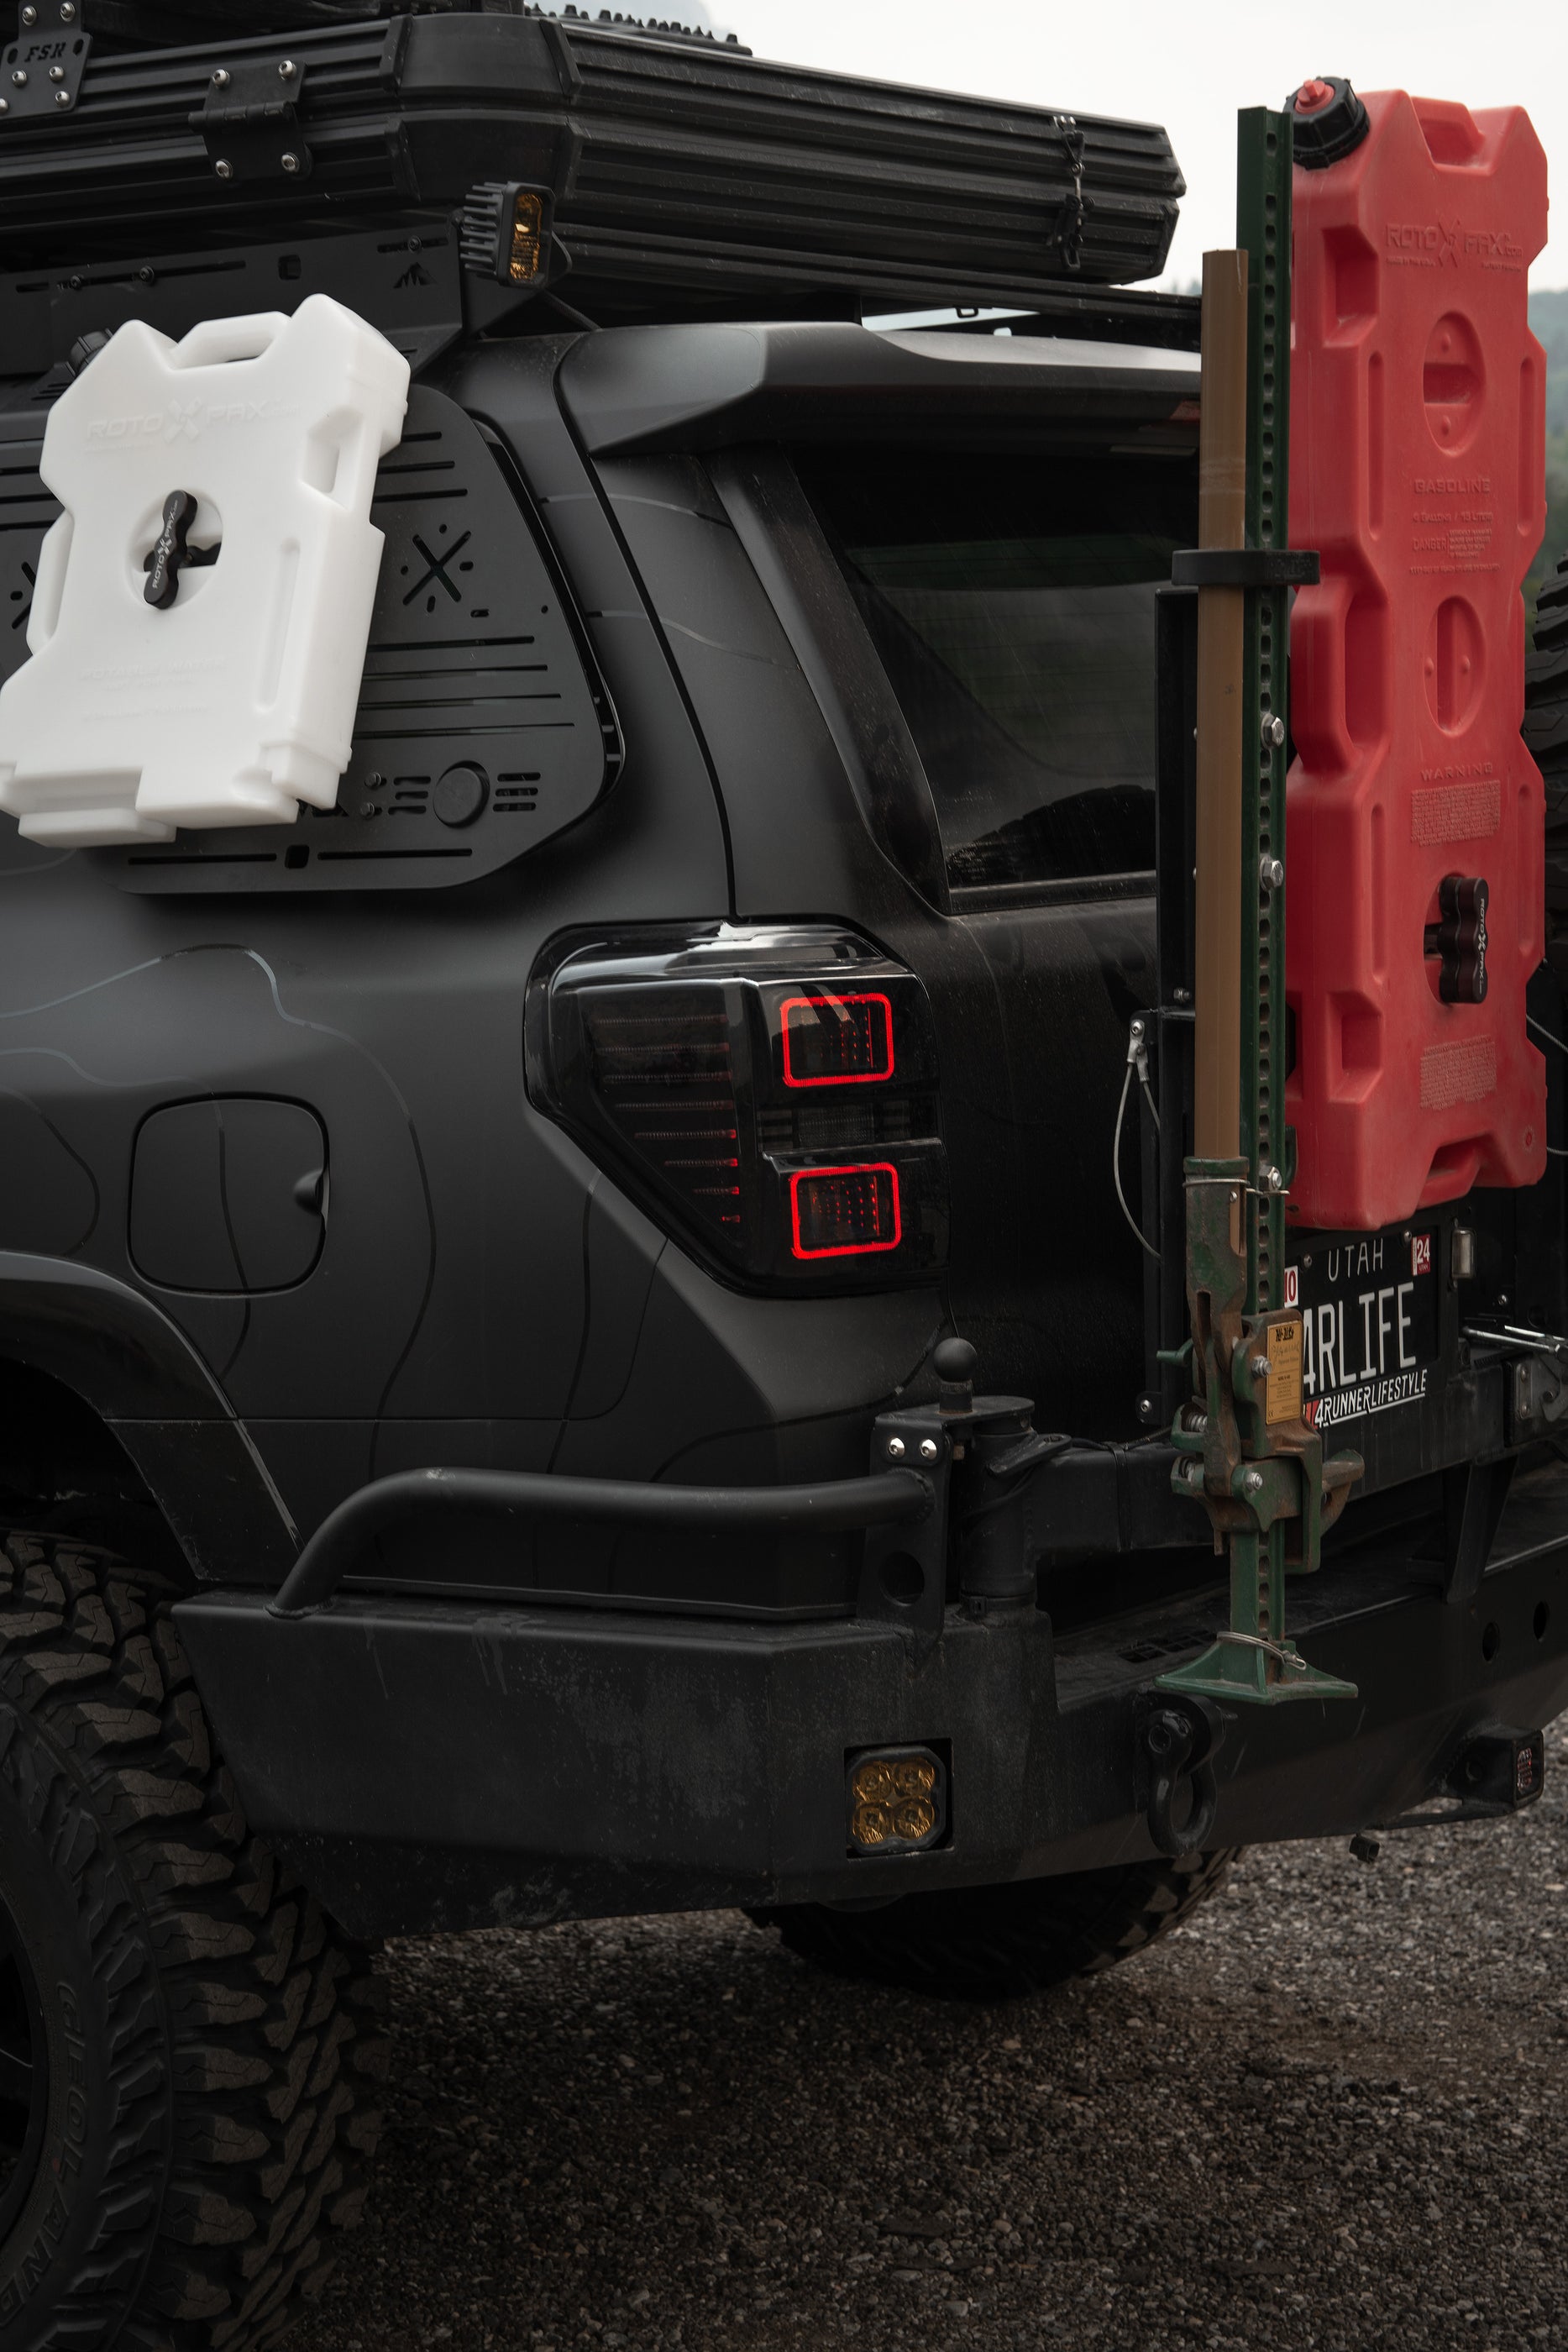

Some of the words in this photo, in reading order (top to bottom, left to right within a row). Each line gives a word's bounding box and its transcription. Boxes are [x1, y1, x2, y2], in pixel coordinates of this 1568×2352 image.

[1414, 477, 1492, 494] GASOLINE
[1412, 538, 1447, 552] DANGER
[1419, 762, 1493, 782] WARNING
[1328, 1238, 1385, 1282] UTAH
[1416, 1237, 1431, 1264] 24
[1303, 1282, 1417, 1394] 4RLIFE
[1314, 1369, 1428, 1428] 4RUNNERLIFESTYLE
